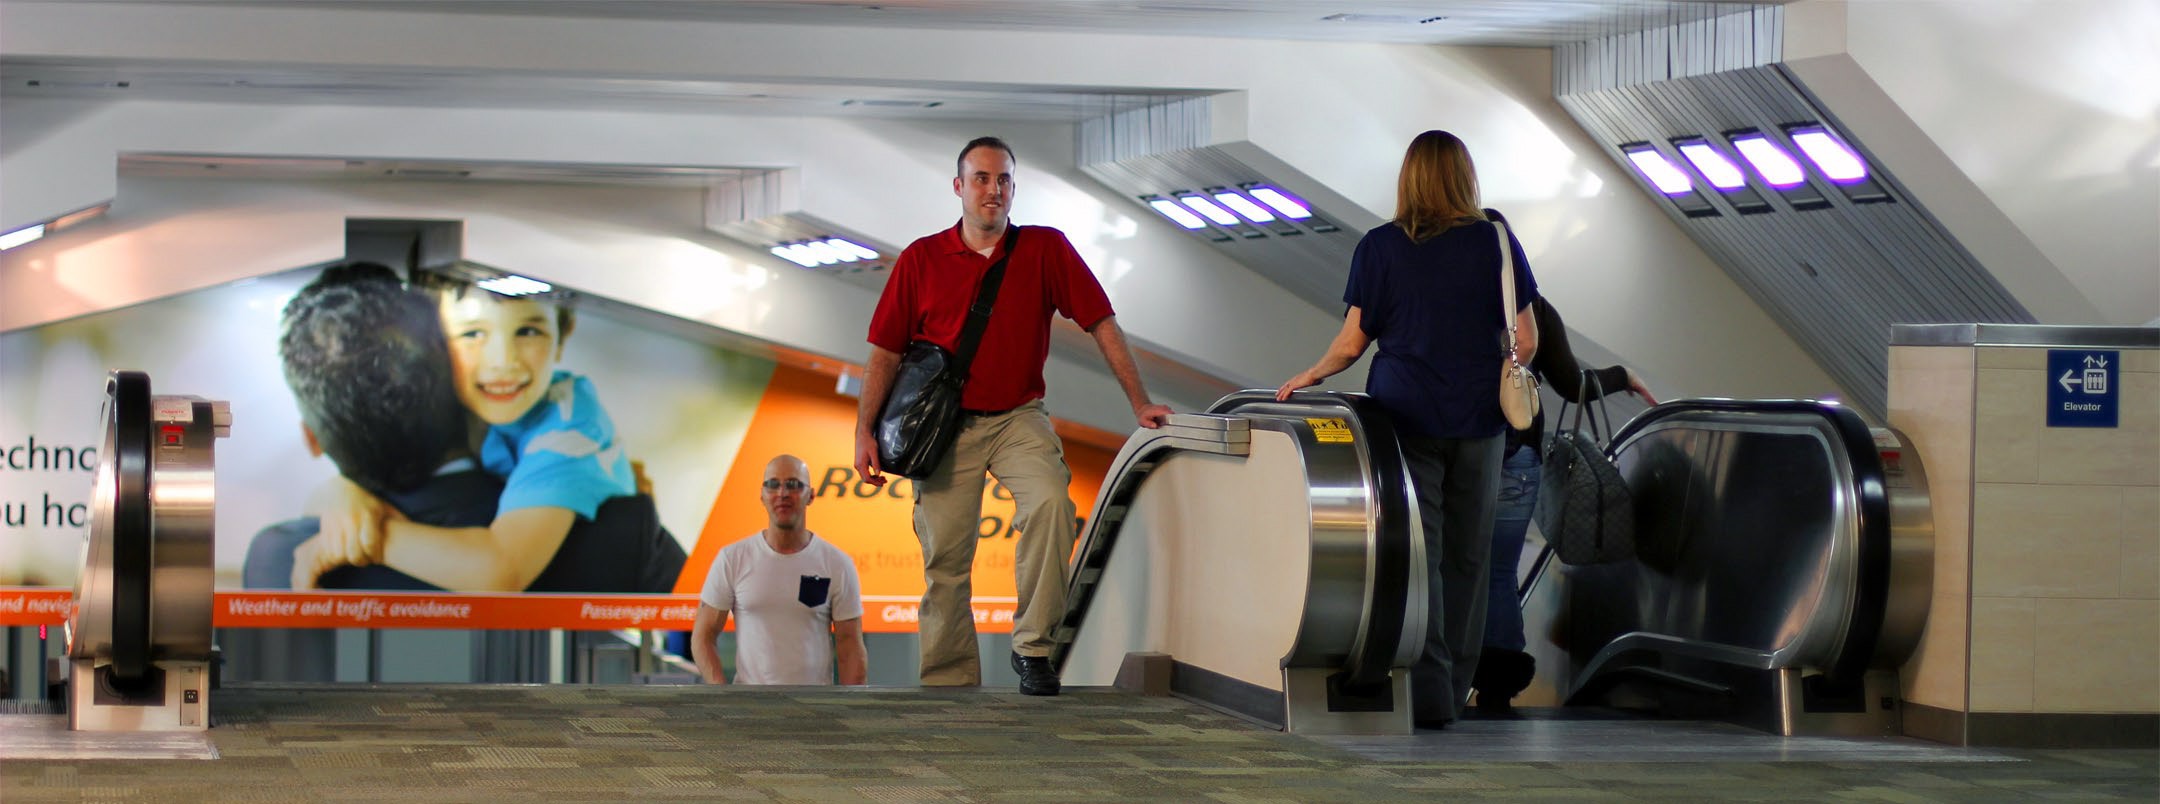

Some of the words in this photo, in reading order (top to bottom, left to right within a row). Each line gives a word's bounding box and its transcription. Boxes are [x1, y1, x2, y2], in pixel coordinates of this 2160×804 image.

[2064, 401, 2101, 411] Elevator
[43, 491, 87, 527] ho
[27, 595, 72, 619] navig
[228, 598, 298, 616] Weather
[300, 599, 333, 616] and
[336, 598, 385, 621] traffic
[389, 599, 472, 619] avoidance
[580, 602, 659, 624] Passenger
[661, 603, 698, 621] ente
